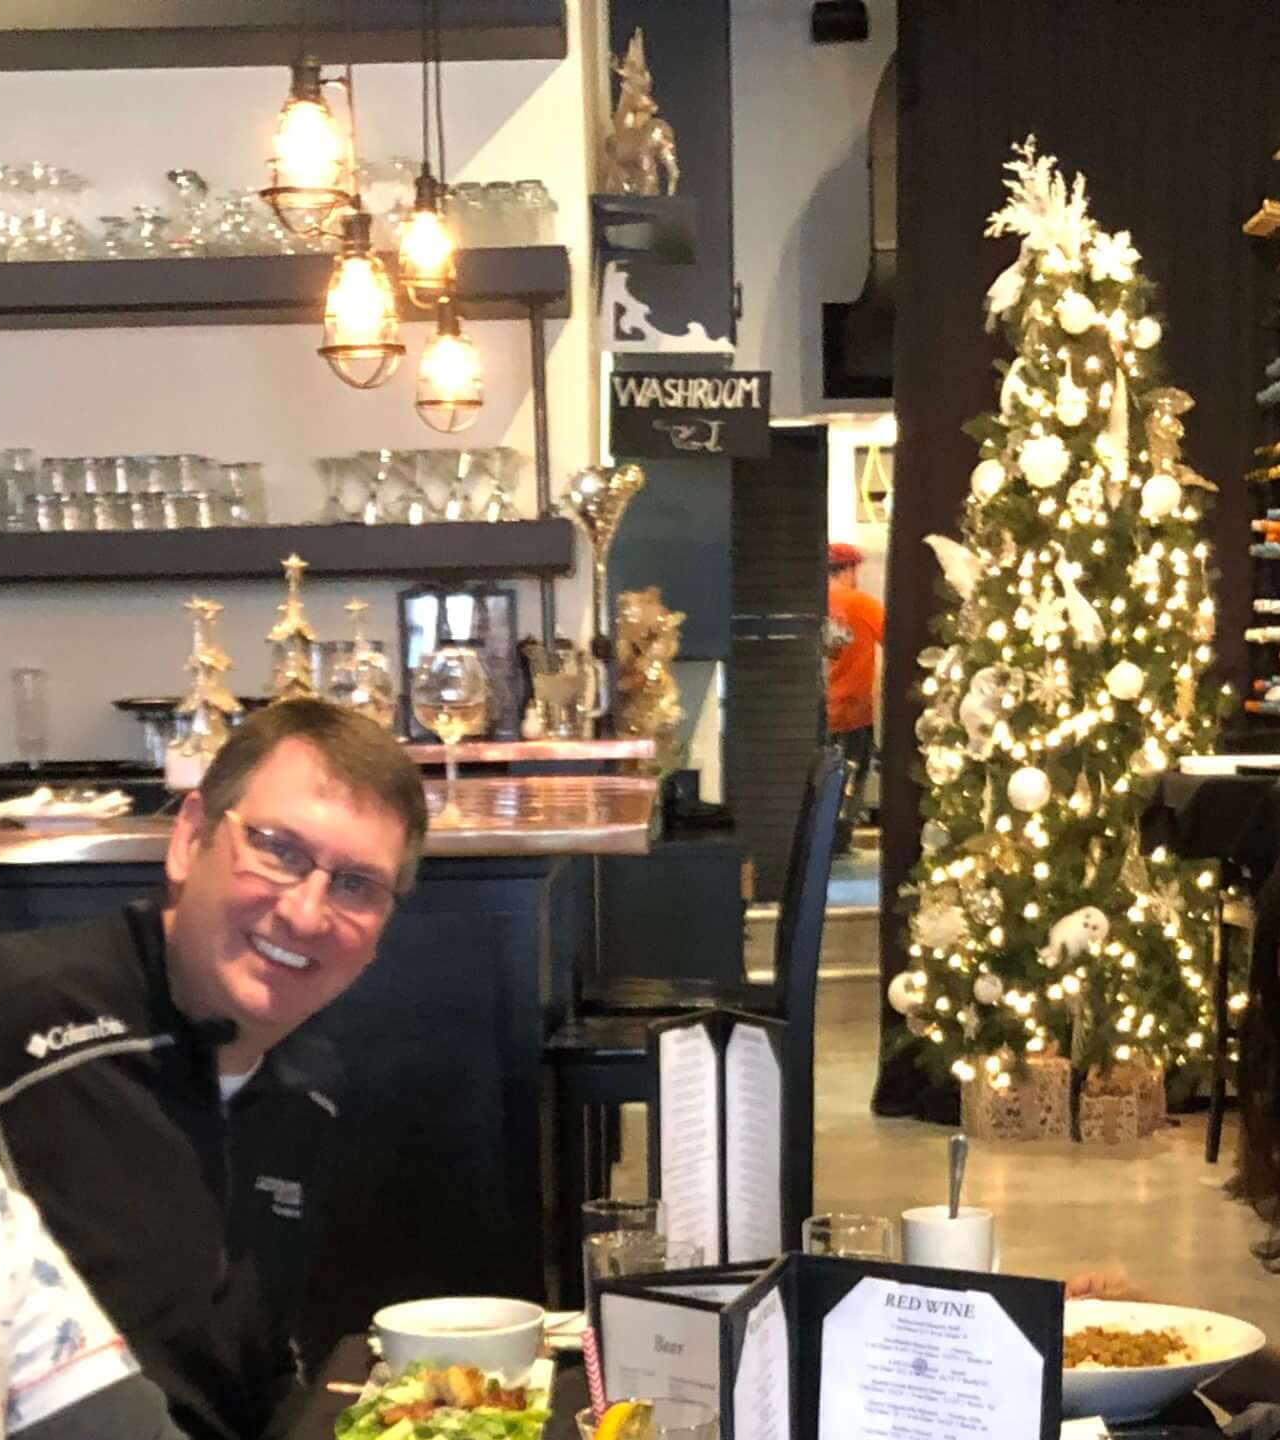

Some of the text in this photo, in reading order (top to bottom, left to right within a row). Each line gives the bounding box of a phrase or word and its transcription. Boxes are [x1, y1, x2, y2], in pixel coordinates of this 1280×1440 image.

[612, 376, 762, 408] WASHROOM
[884, 1292, 976, 1320] RED WINE
[654, 1333, 685, 1355] Beer
